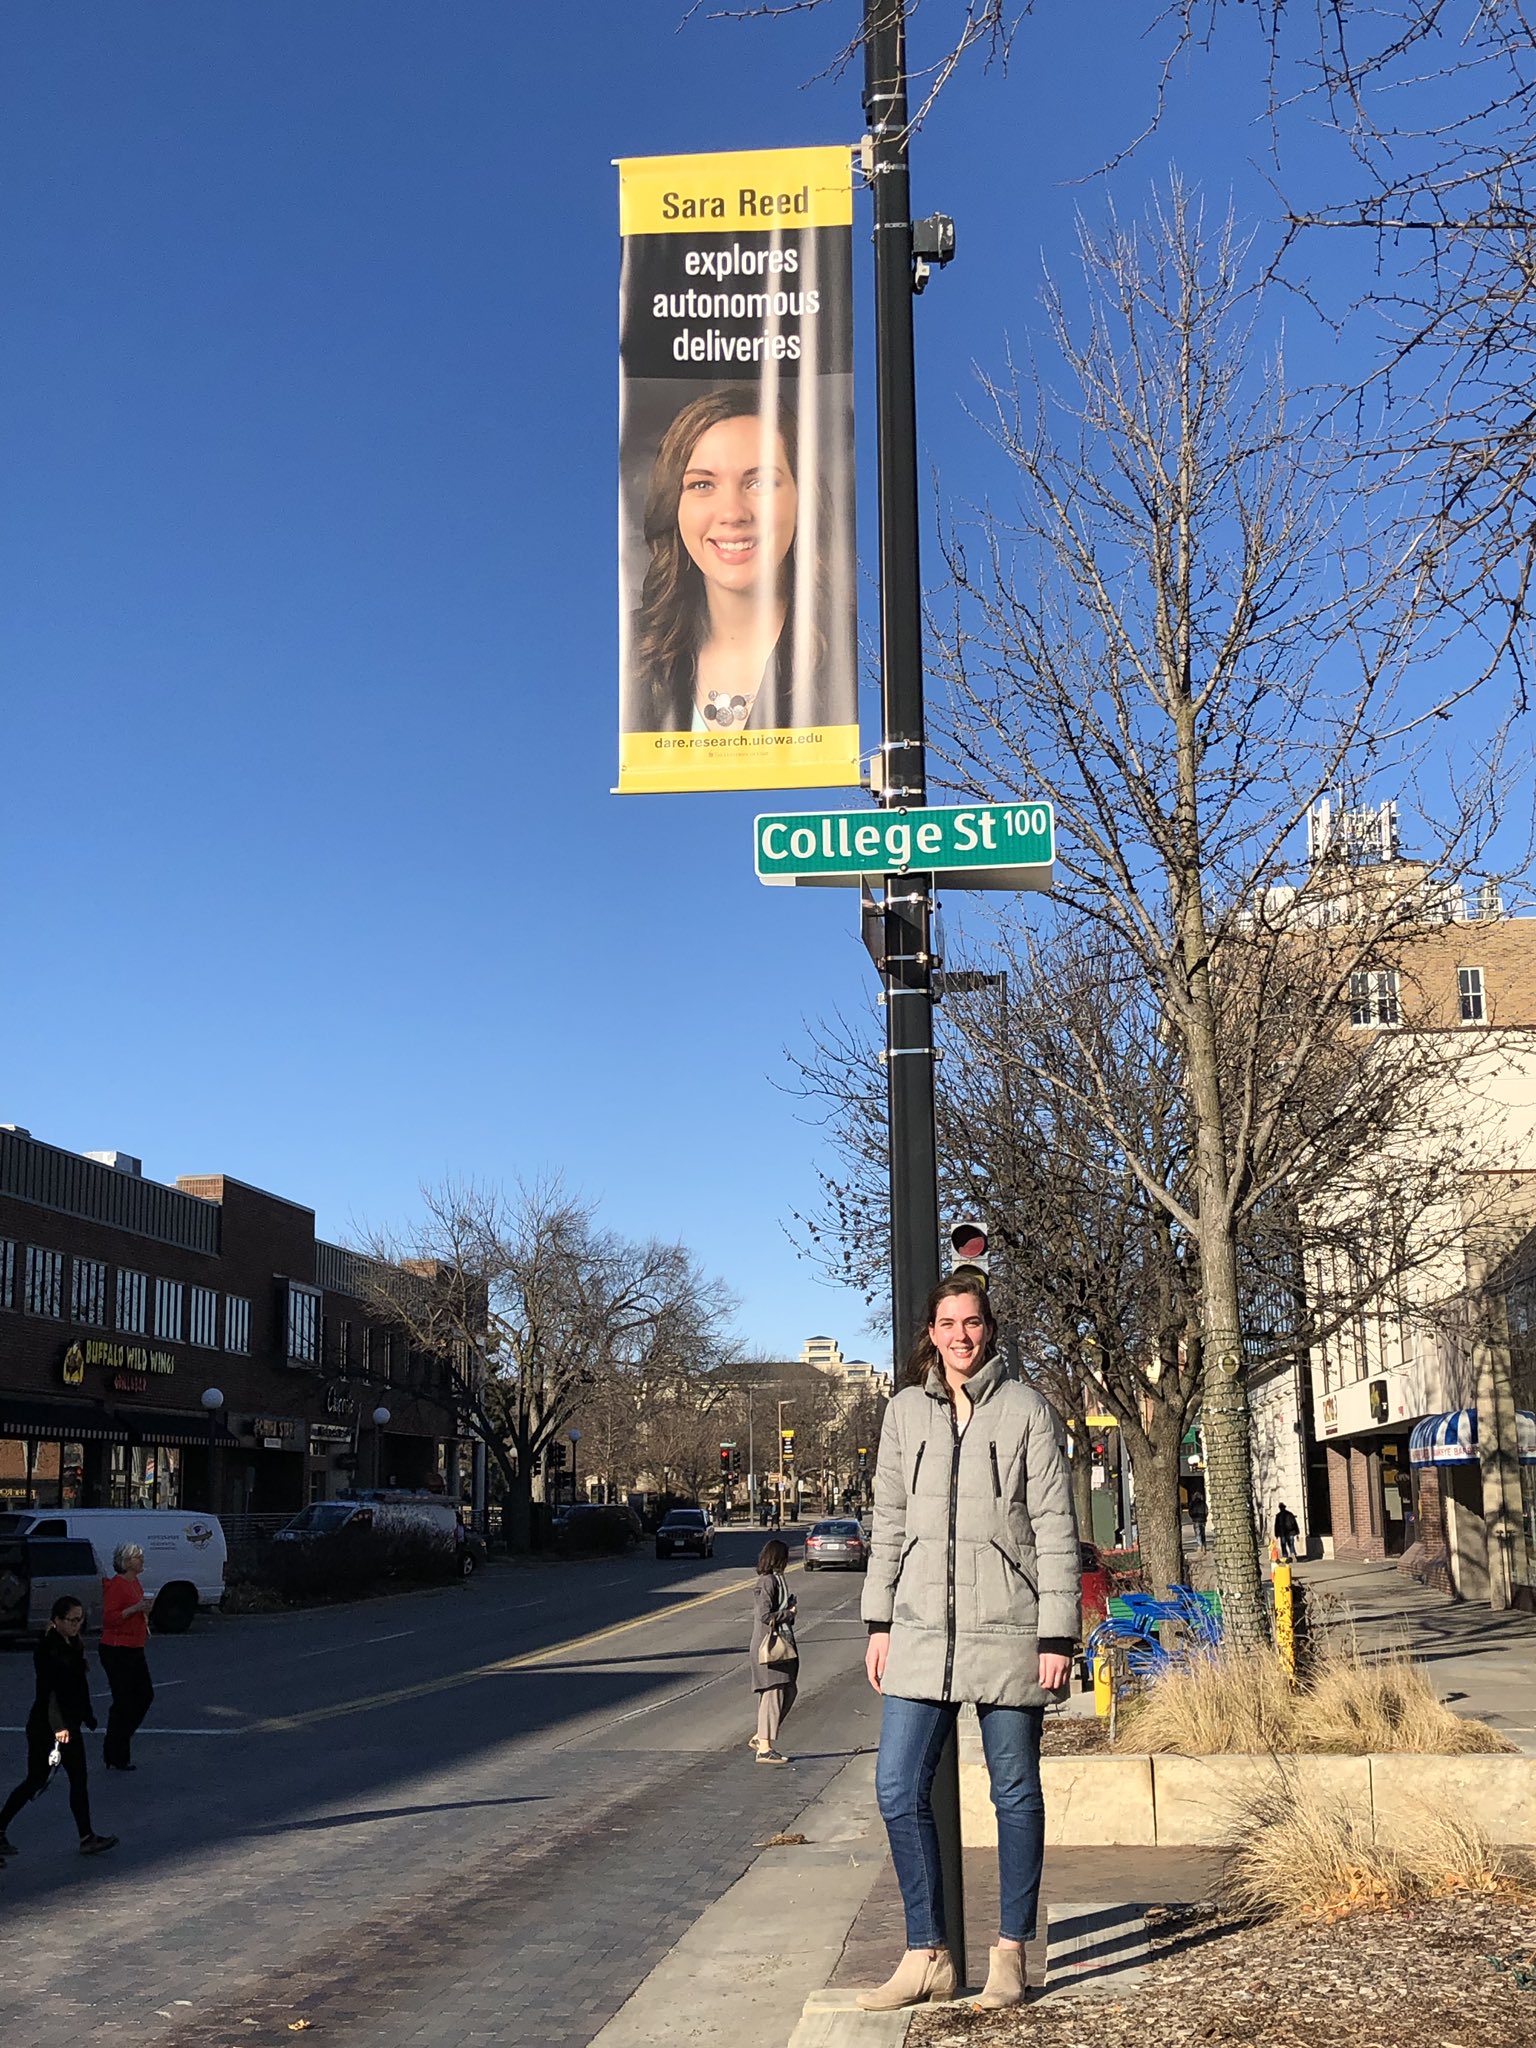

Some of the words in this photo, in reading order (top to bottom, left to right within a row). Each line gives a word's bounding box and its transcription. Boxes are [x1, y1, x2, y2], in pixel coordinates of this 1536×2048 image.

[662, 191, 726, 220] Sara
[738, 185, 809, 217] Reed
[684, 242, 799, 282] explores
[652, 287, 820, 319] autonomous
[672, 328, 801, 362] deliveries
[654, 732, 824, 749] dare.research.uiowa.edu
[761, 817, 942, 865] College
[953, 811, 998, 851] St
[1003, 808, 1047, 837] 100
[85, 1339, 124, 1367] BUFFALO
[126, 1345, 148, 1372] WILD
[150, 1350, 175, 1375] WINGS
